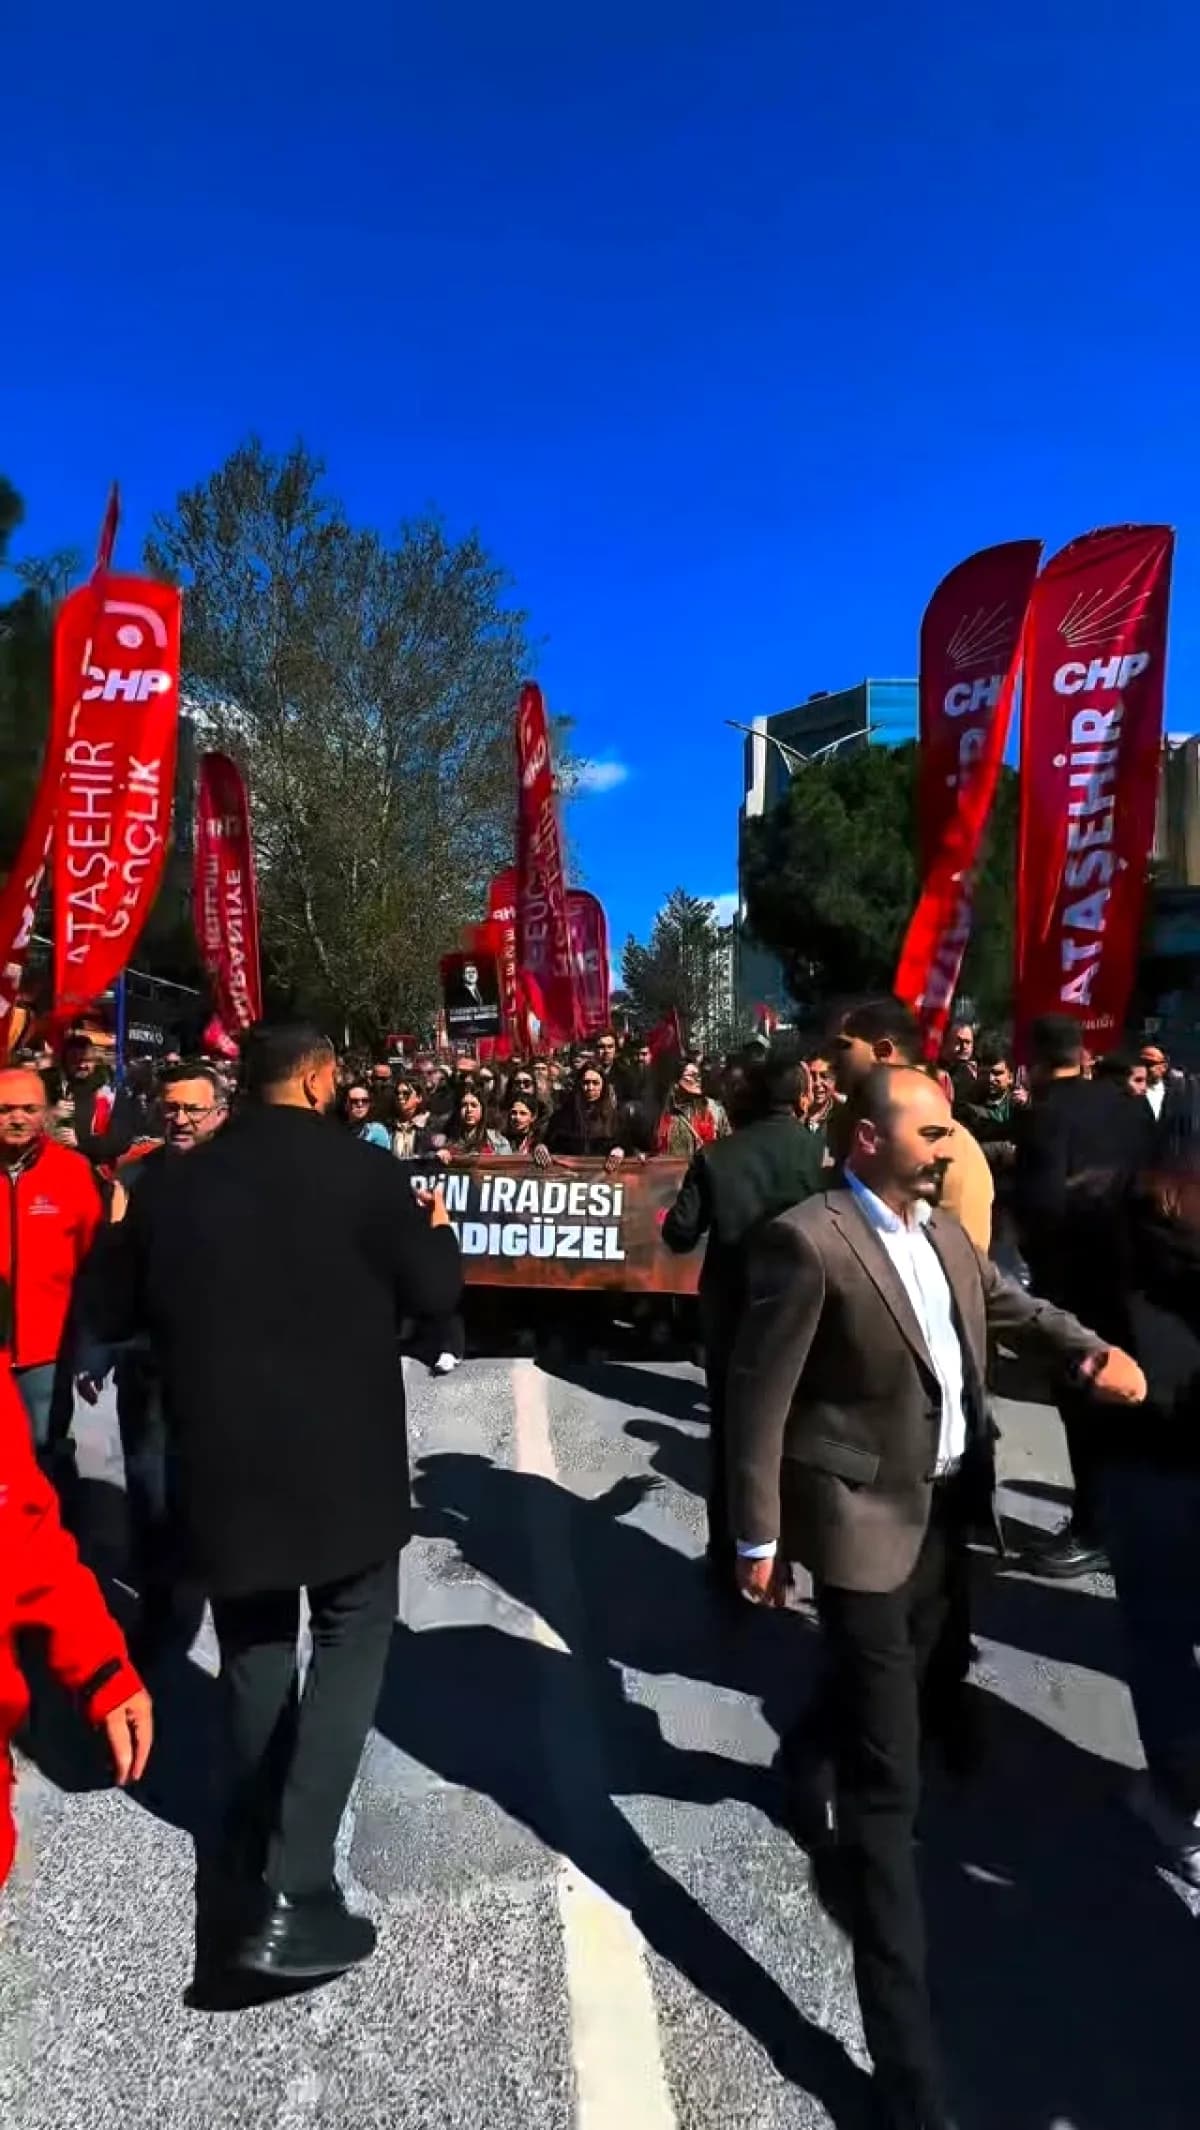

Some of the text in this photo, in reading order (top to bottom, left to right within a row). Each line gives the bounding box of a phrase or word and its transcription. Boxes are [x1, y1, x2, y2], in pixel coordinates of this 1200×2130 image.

[1054, 651, 1150, 694] CHP
[944, 674, 1008, 716] CH
[1053, 700, 1128, 1006] ATAŞEHİR
[480, 1175, 625, 1217] İRADESİ
